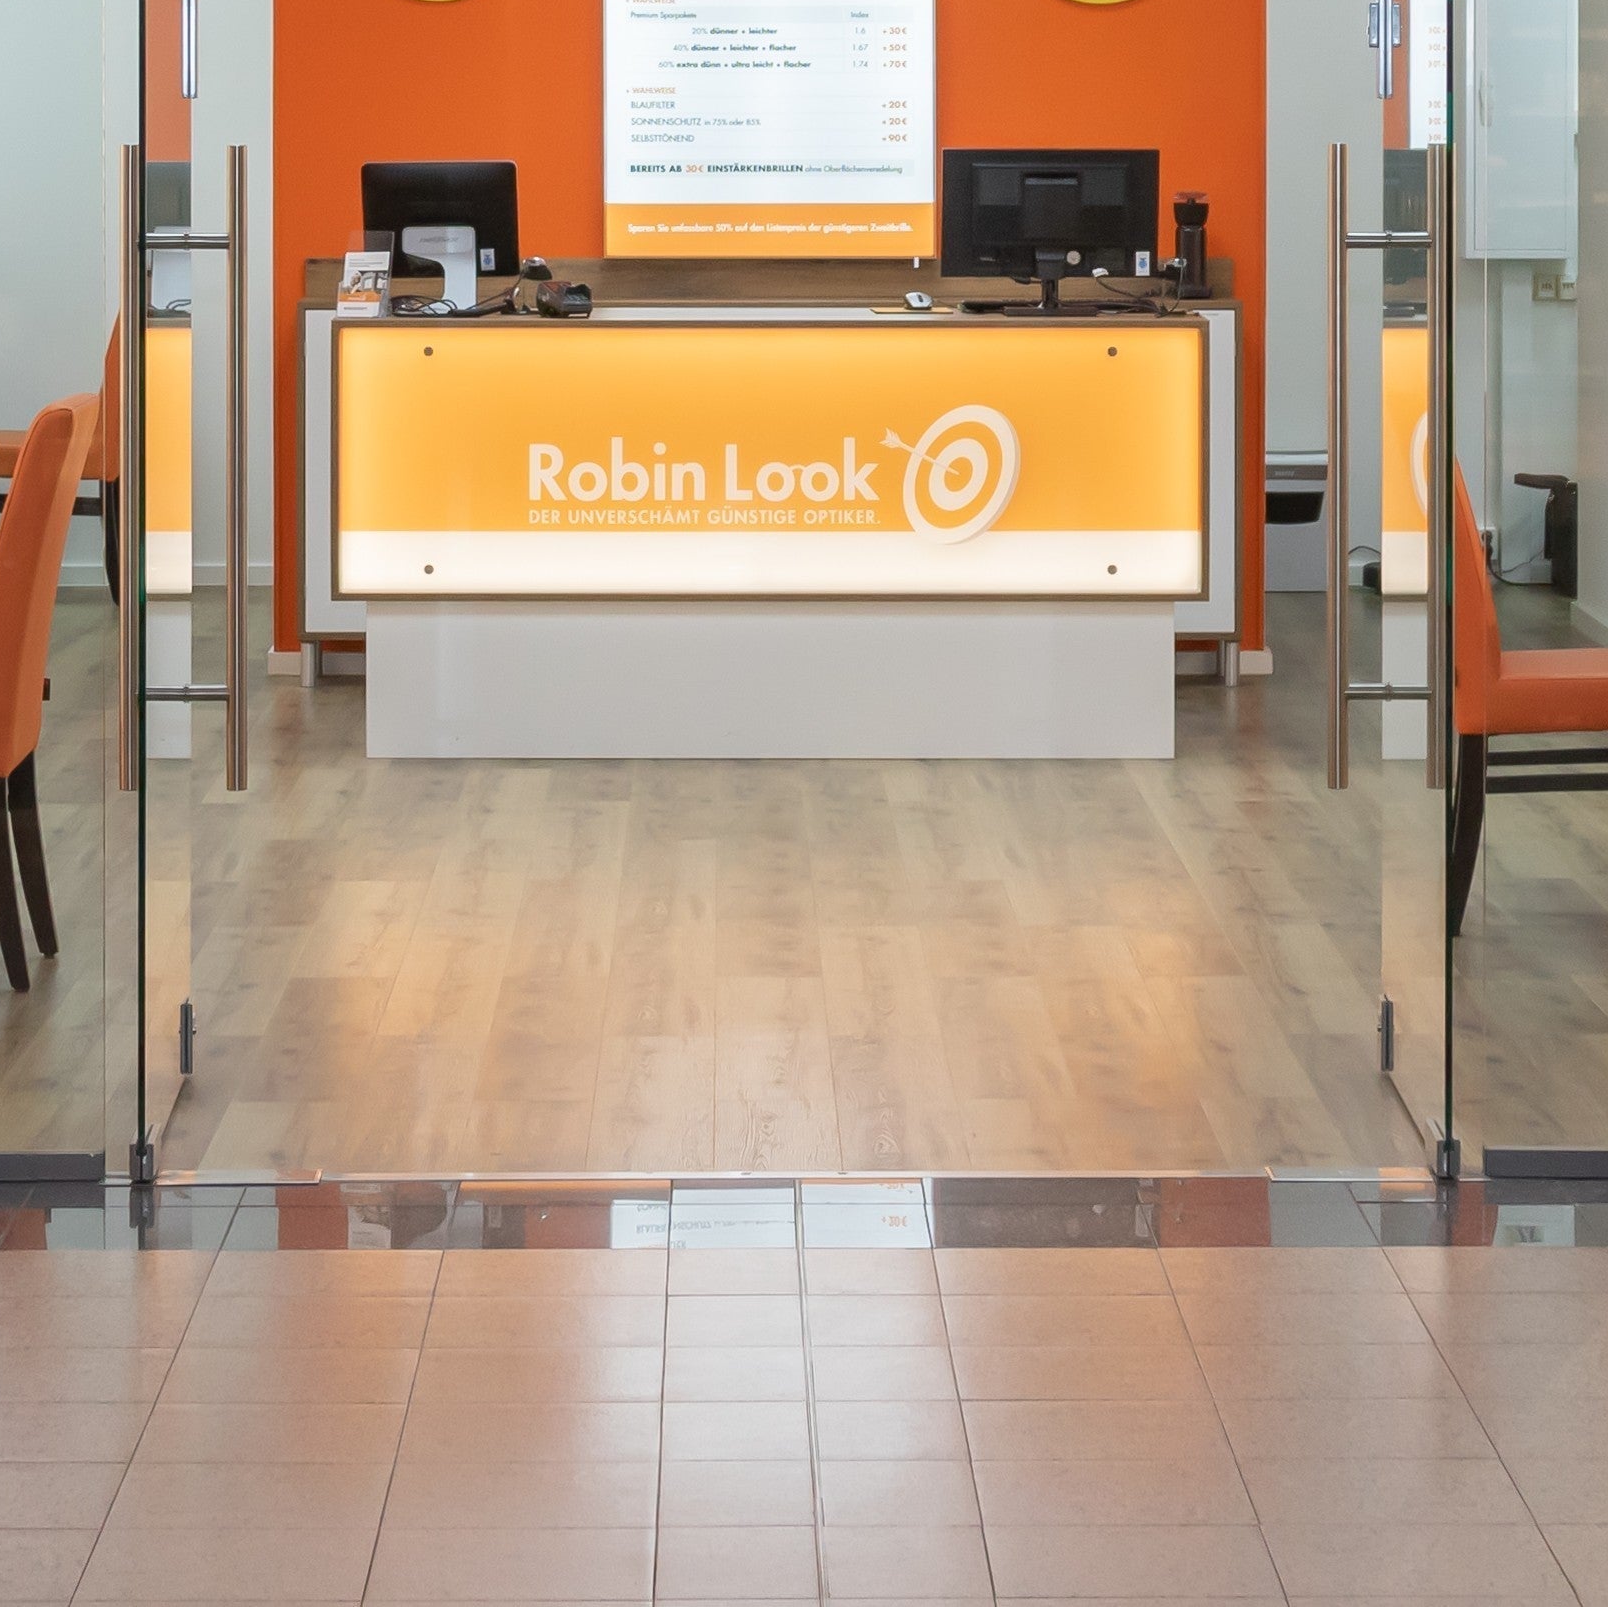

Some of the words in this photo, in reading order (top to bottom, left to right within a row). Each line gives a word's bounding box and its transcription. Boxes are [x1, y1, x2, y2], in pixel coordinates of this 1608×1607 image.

[631, 118, 701, 126] SONNENSCHUTZ
[631, 132, 695, 142] SELBSTTÖNEND
[630, 165, 666, 173] BEREITS
[669, 165, 682, 173] AB
[707, 163, 803, 173] EINSTÄRKENBRILLEN
[528, 436, 705, 502] Robin
[725, 437, 880, 502] Look
[528, 509, 561, 525] DER
[568, 505, 701, 525] UNVERSCHÄMT
[707, 505, 797, 525] GÜNSTIGE
[804, 509, 881, 525] OPTIKER.
